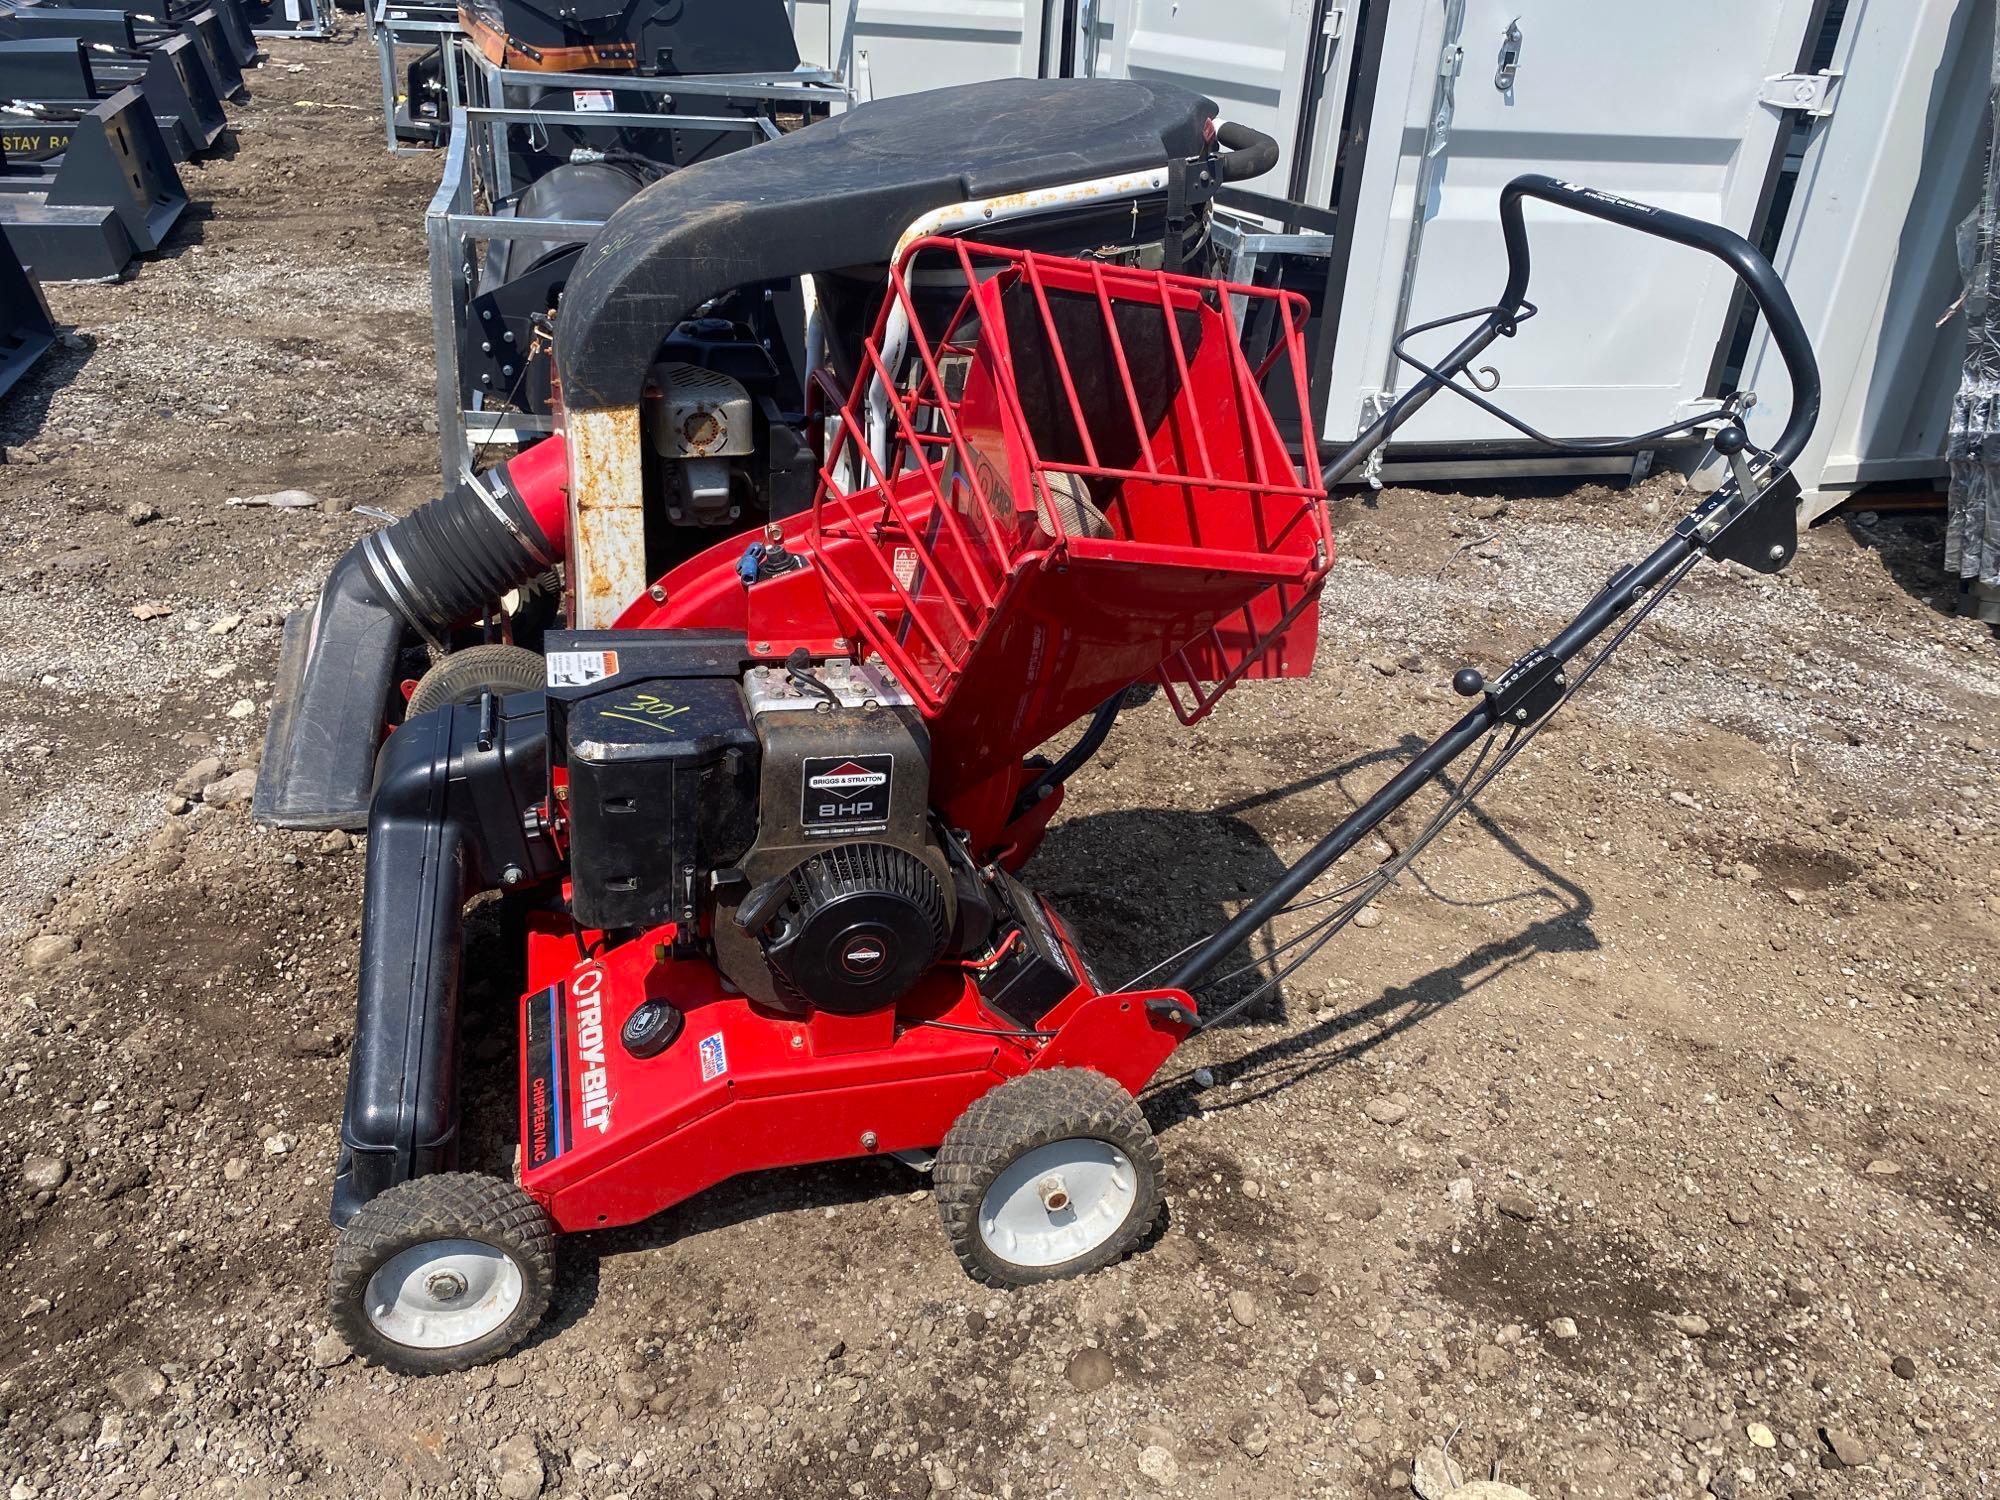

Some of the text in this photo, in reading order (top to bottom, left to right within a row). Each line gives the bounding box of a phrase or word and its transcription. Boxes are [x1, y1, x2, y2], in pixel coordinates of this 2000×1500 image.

[3, 136, 70, 150] STAY BA
[1707, 501, 1718, 510] 2
[1495, 654, 1544, 695] ENGINE
[614, 694, 690, 720] 301
[812, 778, 840, 786] BRIGGS
[847, 775, 883, 784] STRATTON
[576, 992, 609, 1133] TROY-BILT
[533, 1077, 547, 1162] CHIPPER/VAC
